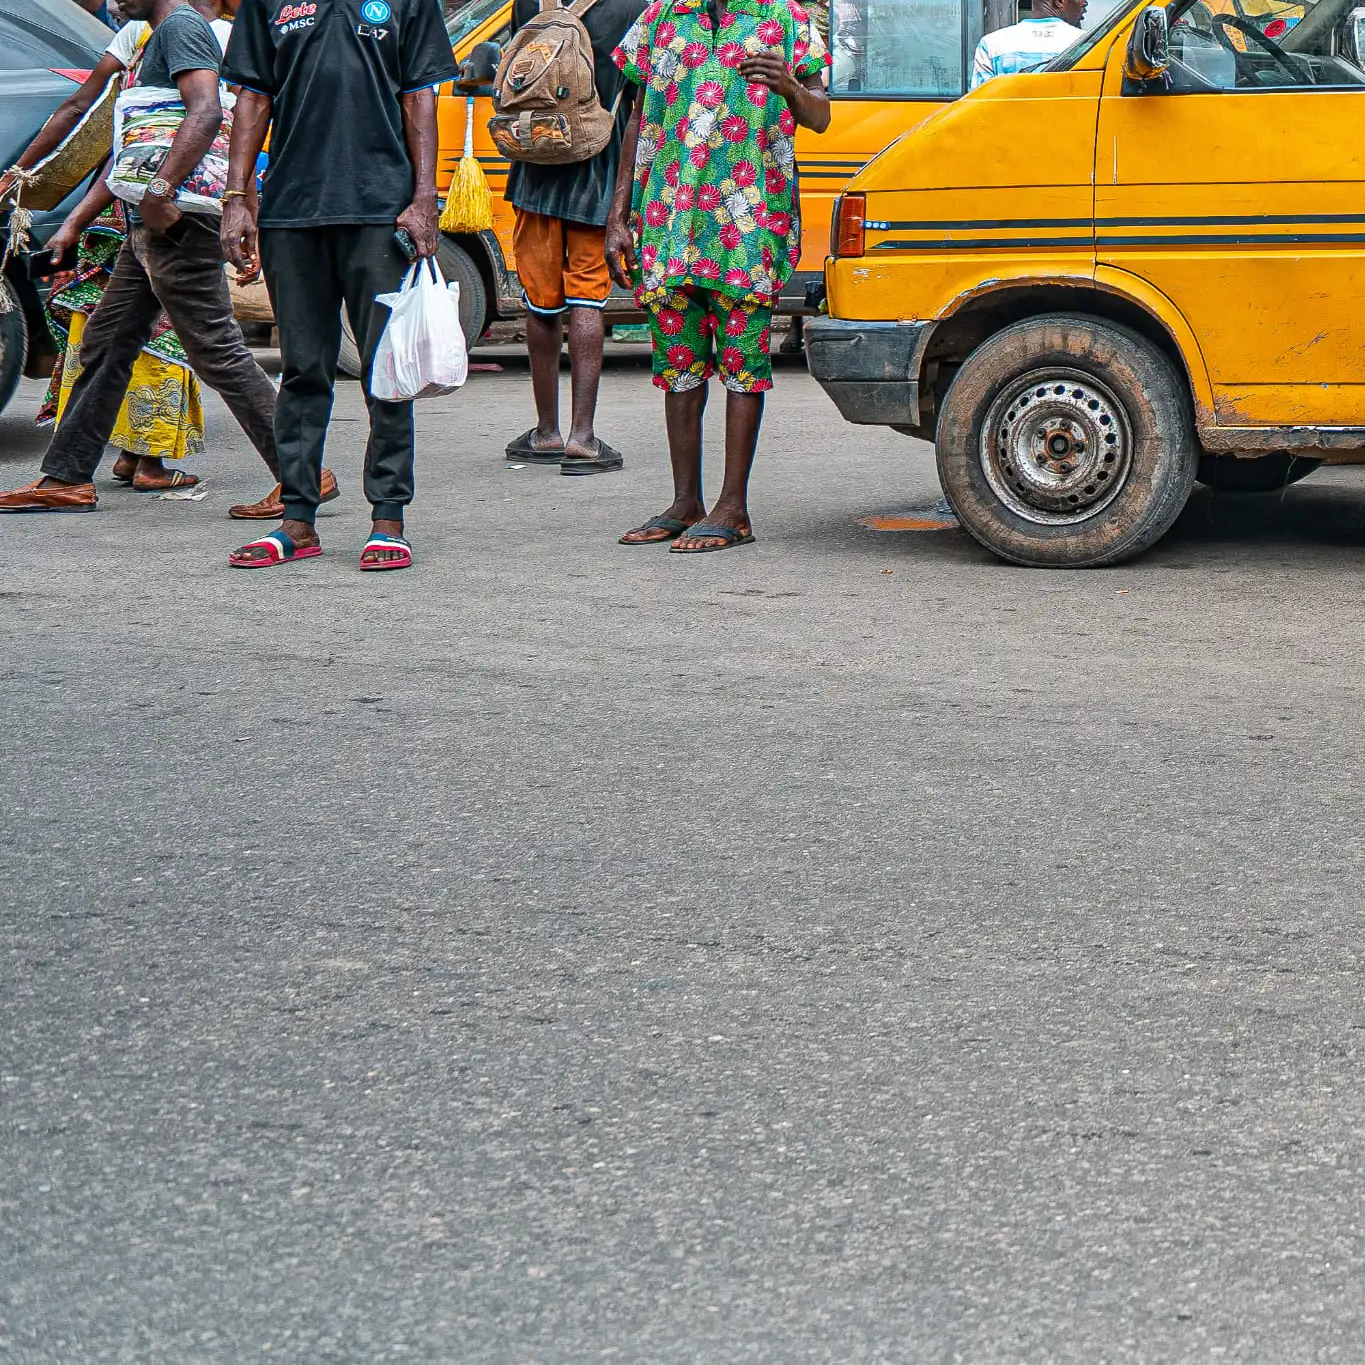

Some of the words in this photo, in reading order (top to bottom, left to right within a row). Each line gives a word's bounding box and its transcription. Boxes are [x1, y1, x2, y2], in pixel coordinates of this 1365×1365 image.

[275, 1, 317, 25] Lete
[369, 4, 384, 17] N
[288, 17, 315, 32] MSC
